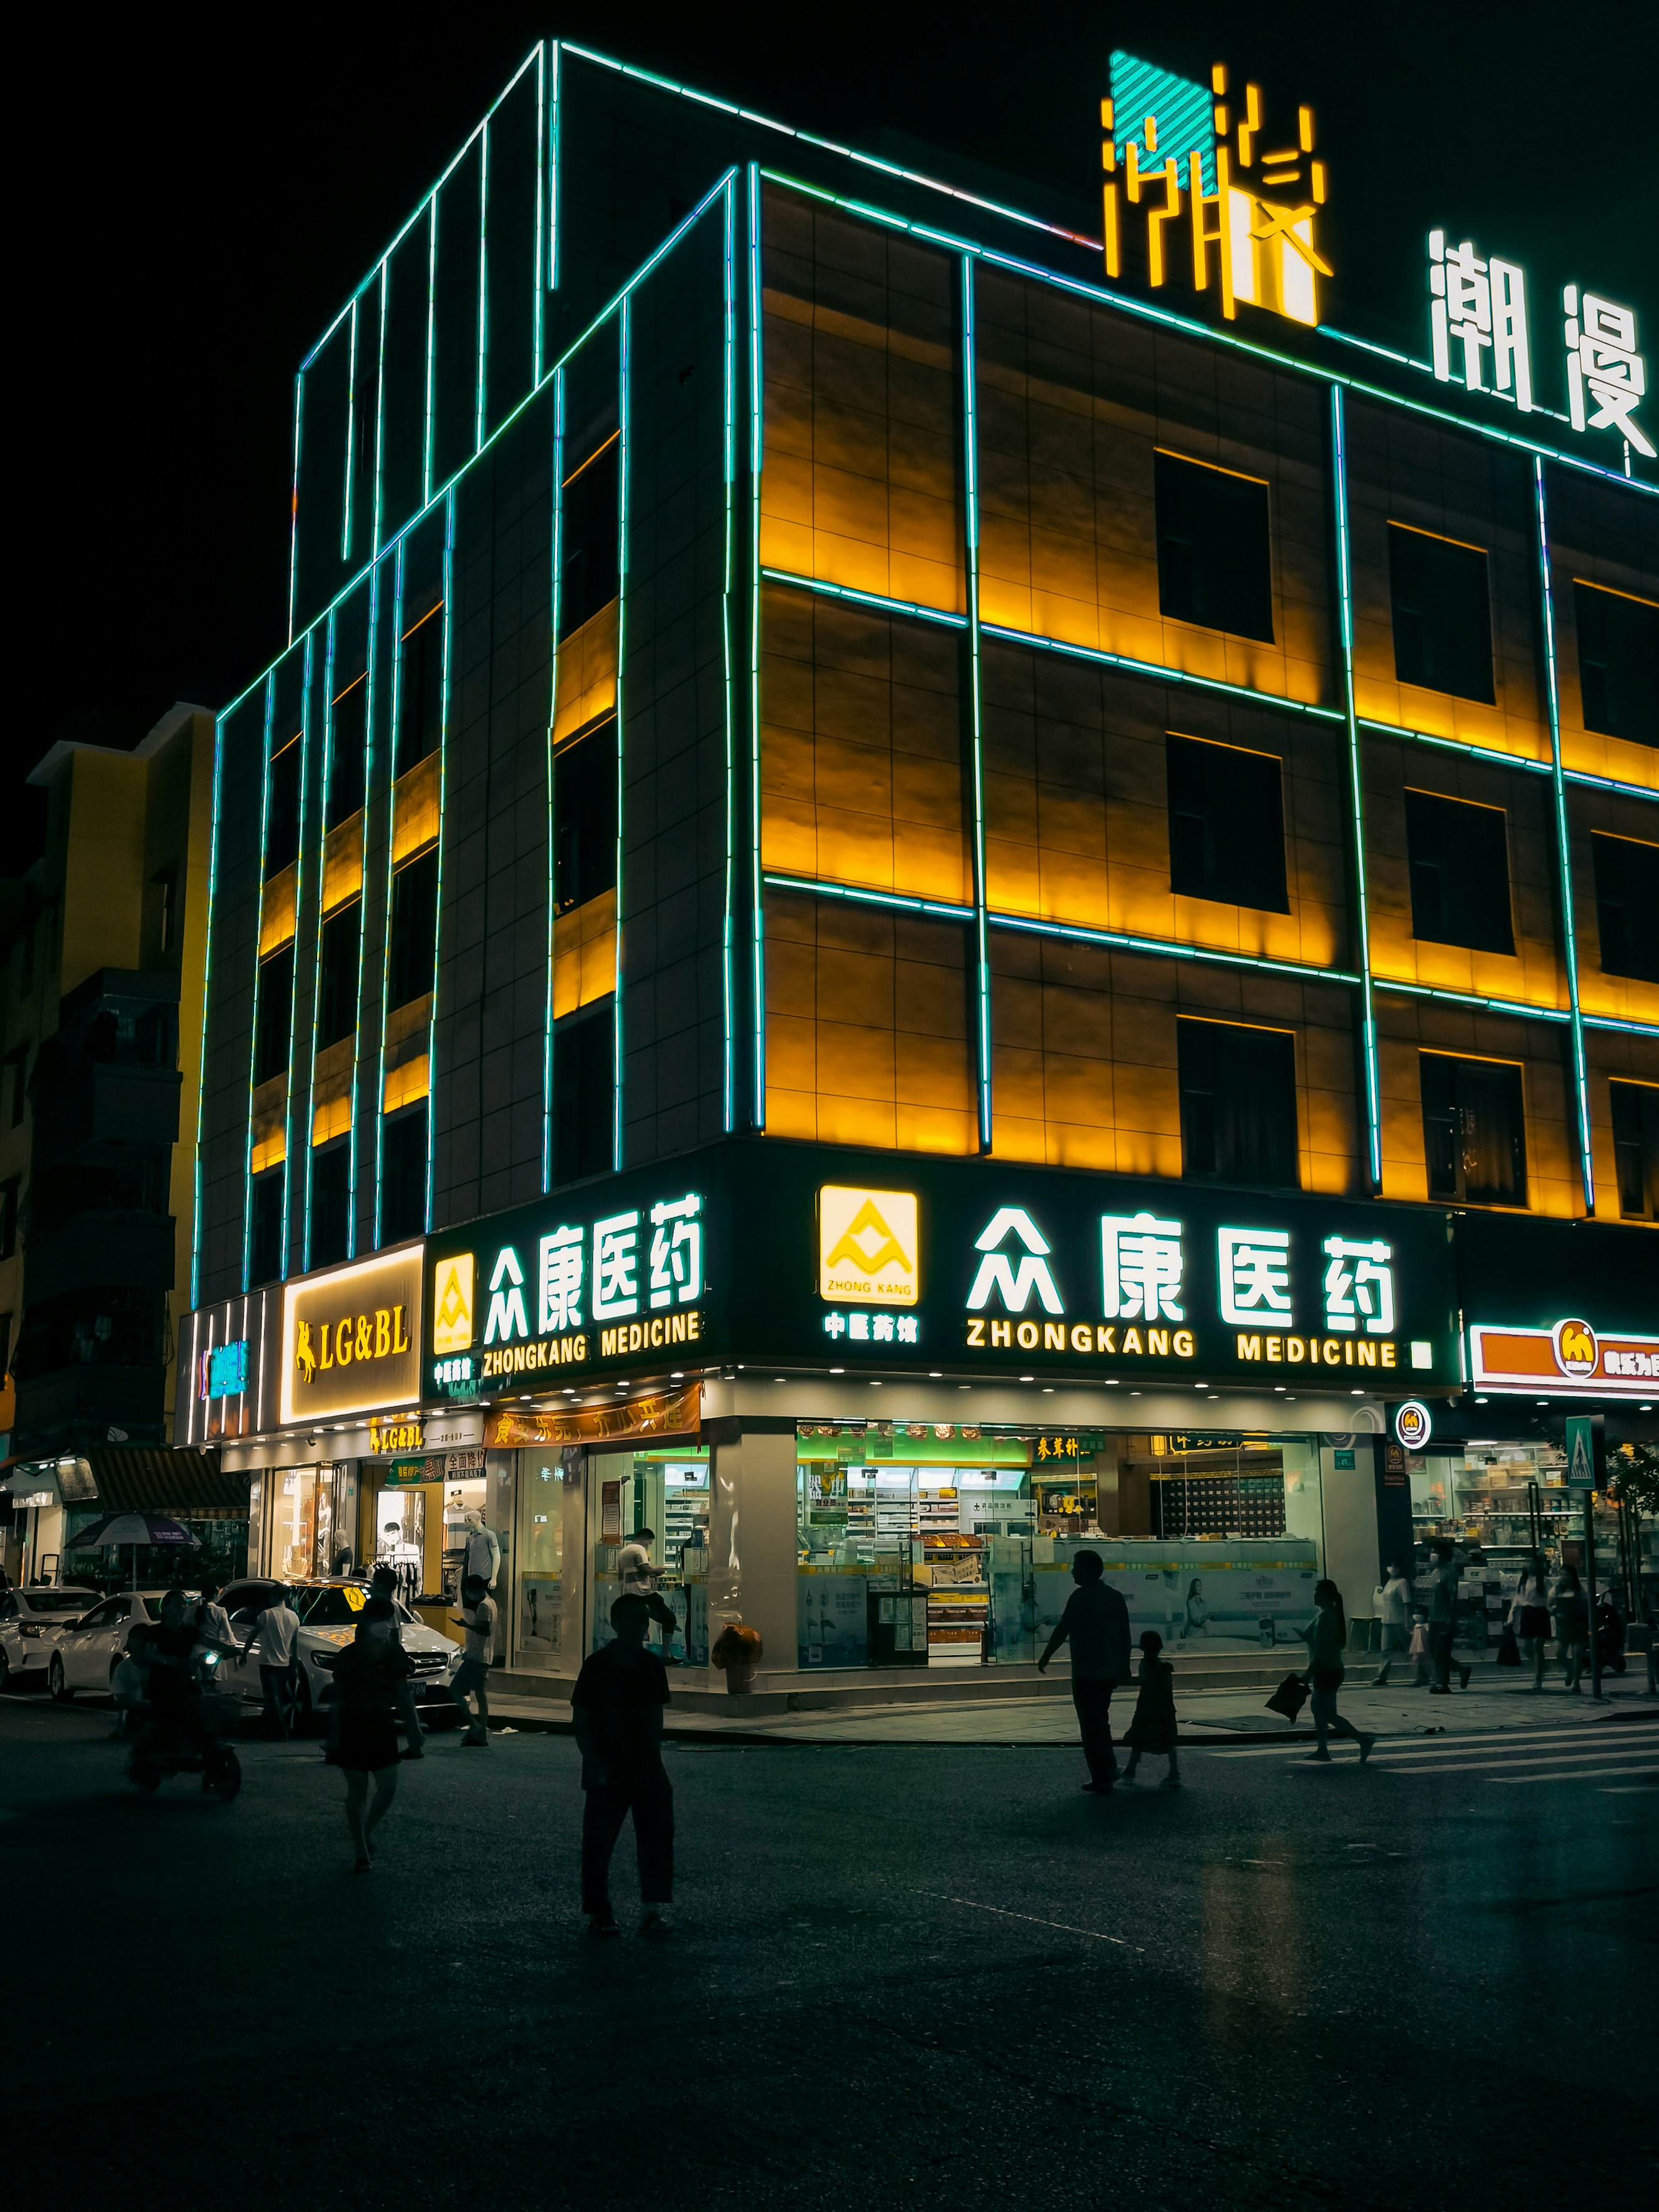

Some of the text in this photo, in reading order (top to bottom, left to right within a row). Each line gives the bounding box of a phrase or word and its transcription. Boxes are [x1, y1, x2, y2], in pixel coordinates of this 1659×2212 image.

[1428, 228, 1658, 458] 潮漫
[484, 1193, 705, 1345] 众康医药
[828, 1280, 911, 1295] ZHONG KANG
[966, 1207, 1394, 1334] 众康医药
[318, 1304, 412, 1371] LG&BL
[483, 1311, 700, 1377] ZHONGKANG MEDICINE
[825, 1312, 918, 1343] 中医药馆
[967, 1319, 1396, 1368] ZHONGKANG MEDICINE
[381, 1426, 423, 1450] LG&BL
[1037, 1436, 1090, 1461] 参茸补
